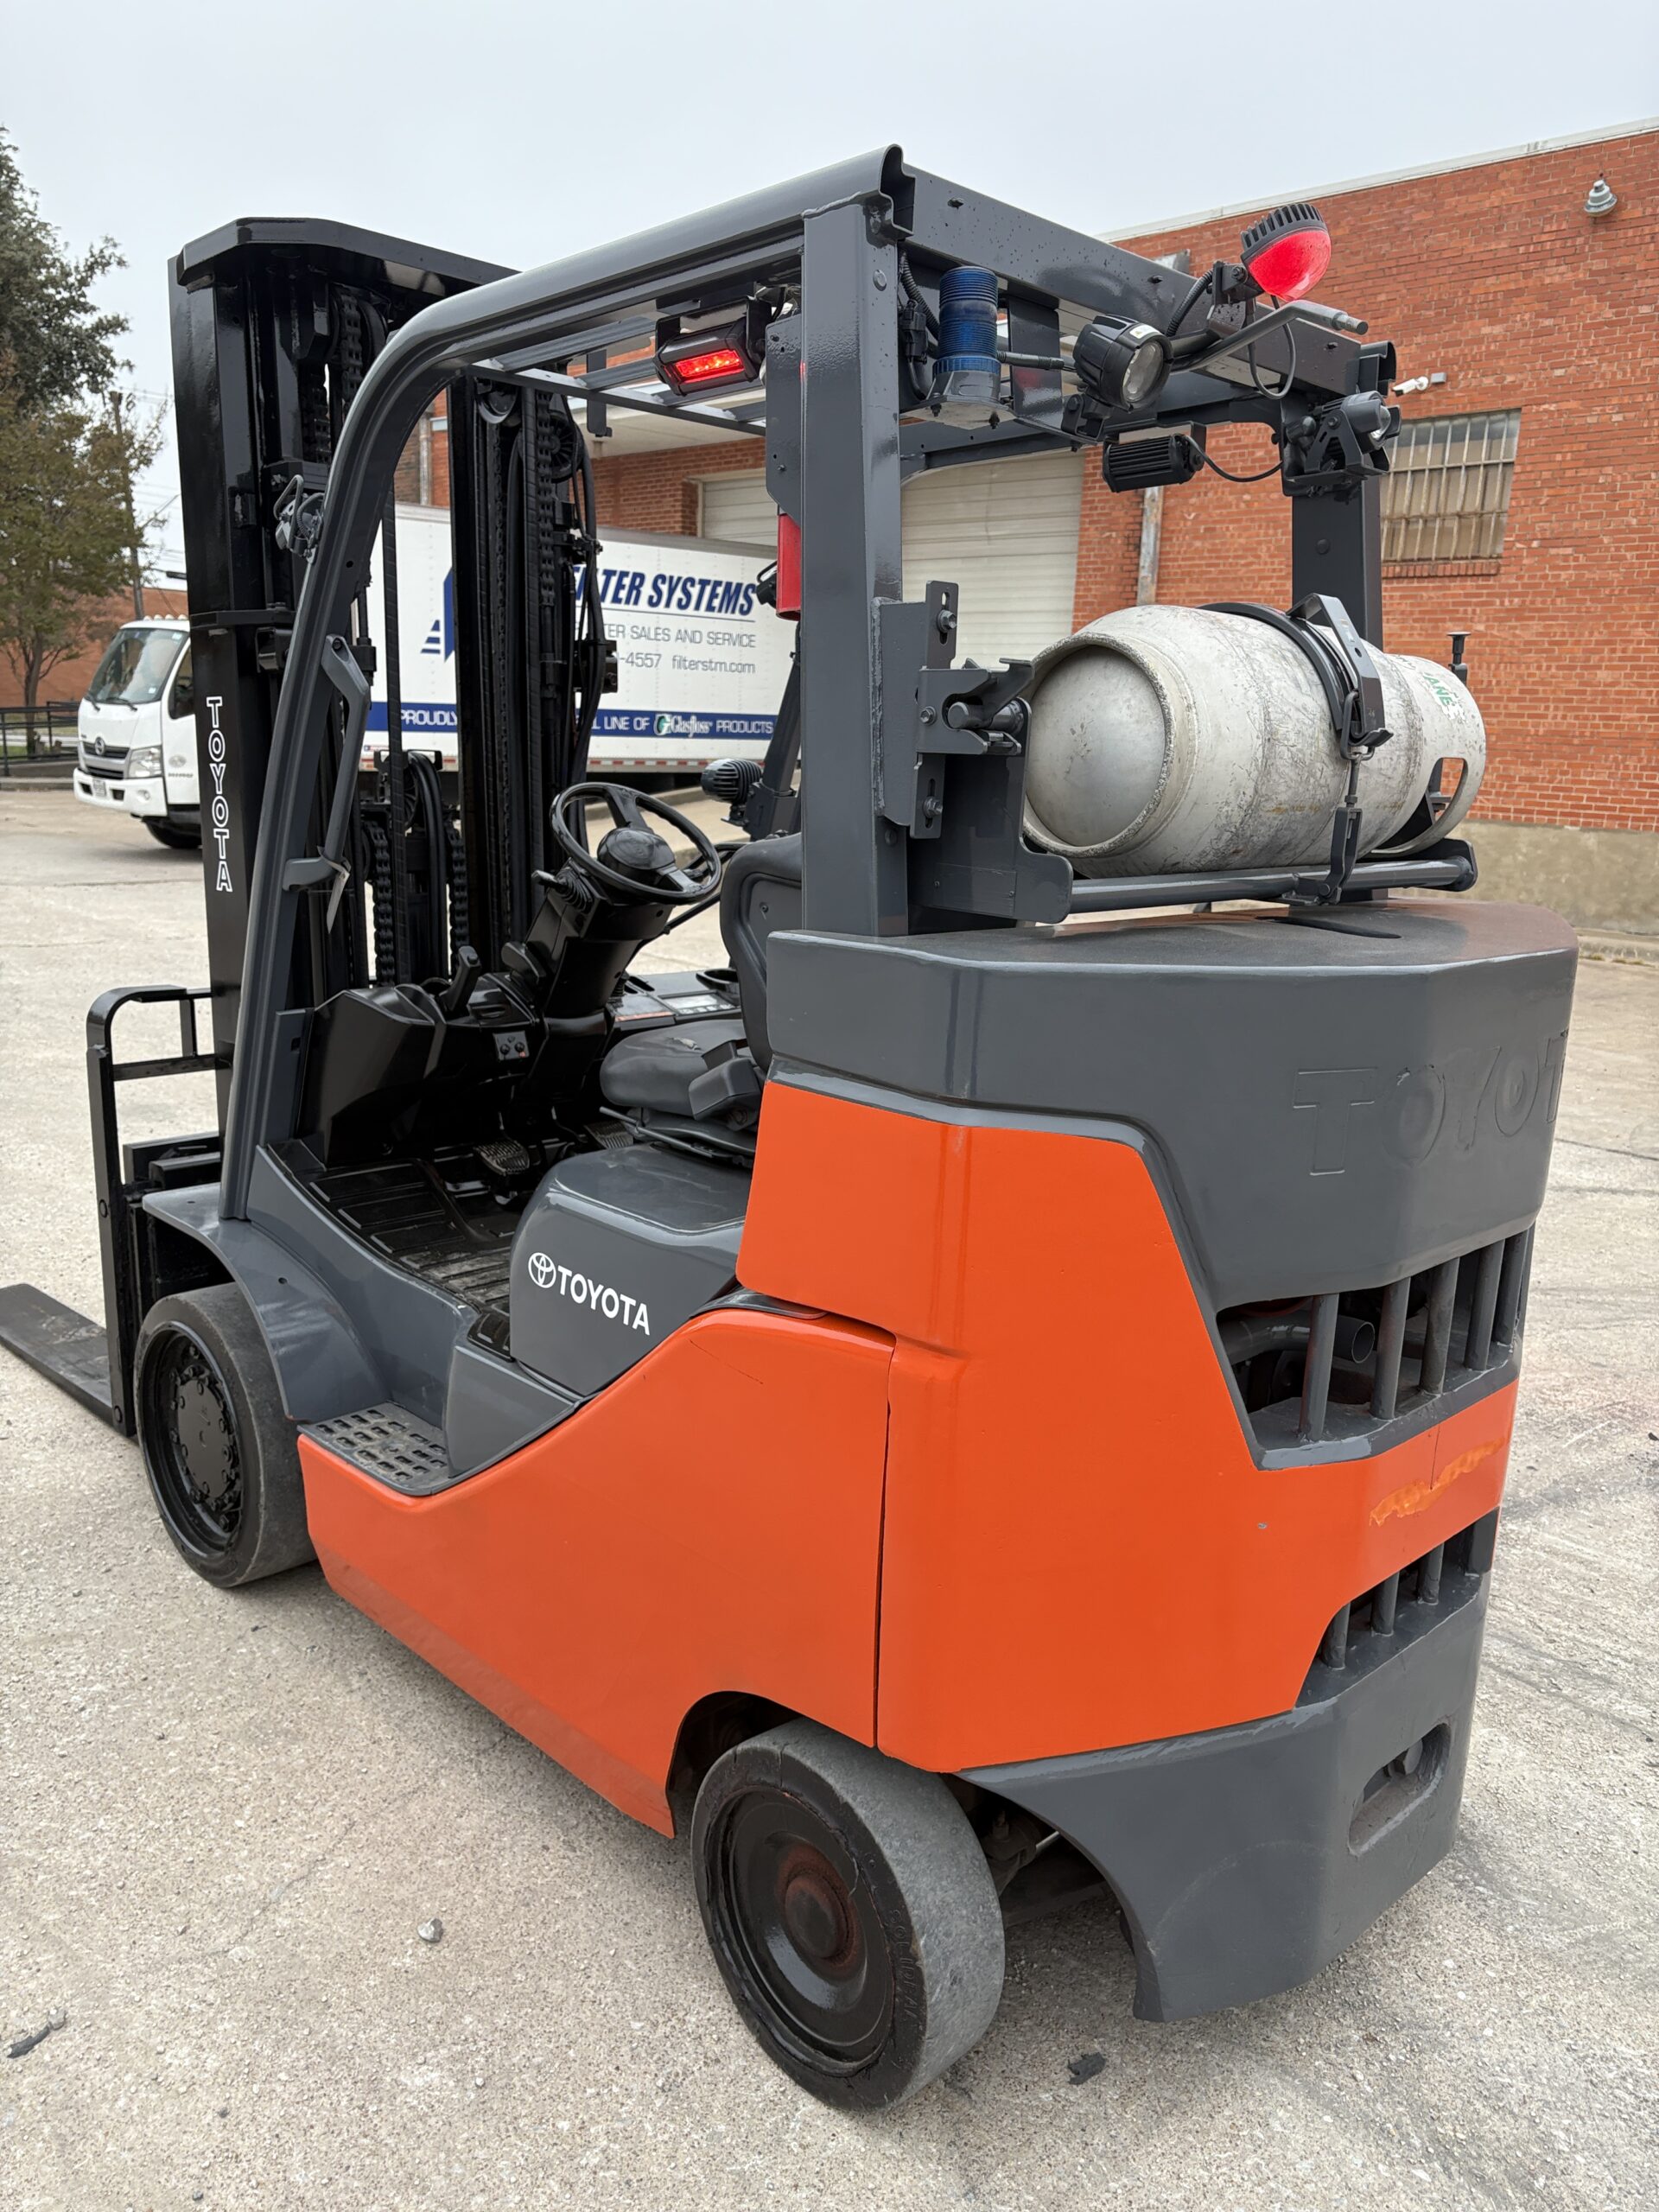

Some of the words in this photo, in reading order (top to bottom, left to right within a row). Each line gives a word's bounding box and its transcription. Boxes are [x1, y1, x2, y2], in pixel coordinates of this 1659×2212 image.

[648, 574, 757, 616] SYSTEMS
[630, 625, 671, 642] SALES
[675, 629, 703, 645] AND
[706, 631, 756, 648] SERVICE
[617, 652, 662, 668] -4557
[672, 655, 756, 674] filterstm.com
[604, 716, 630, 731] LINE
[632, 716, 651, 732] OF
[715, 719, 774, 734] PRODUCTS
[206, 696, 233, 893] TOYOTA
[557, 1264, 651, 1337] TOYOTA
